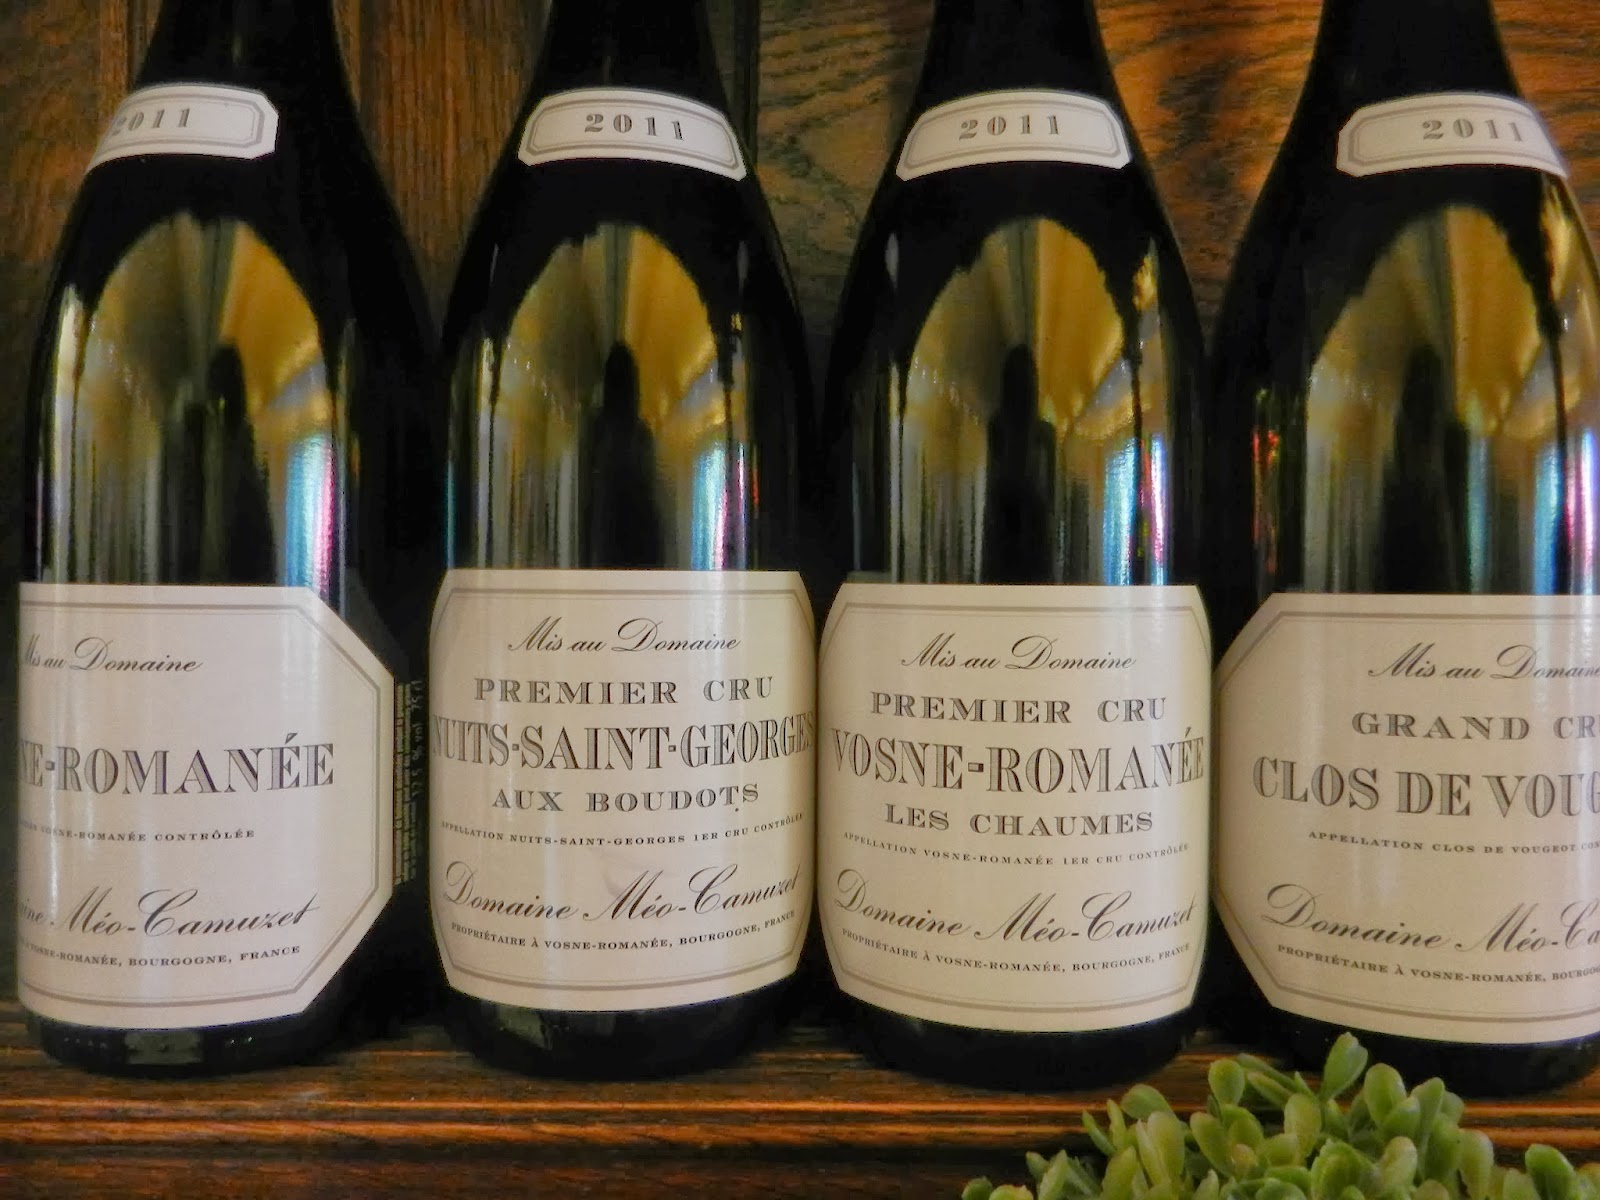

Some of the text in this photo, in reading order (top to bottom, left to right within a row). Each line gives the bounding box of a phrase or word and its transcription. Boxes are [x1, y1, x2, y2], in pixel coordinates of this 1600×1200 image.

[111, 106, 190, 136] 2011
[584, 113, 684, 141] 2011
[958, 114, 1059, 141] 2011
[1422, 118, 1524, 142] 2011
[507, 615, 742, 653] Mis au Domaine
[901, 632, 1138, 671] Mis au Domaine
[44, 656, 67, 669] au
[69, 636, 204, 672] Domaine
[1367, 642, 1437, 678] Mis
[1442, 665, 1486, 679] au
[474, 676, 774, 705] PREMIER CRU
[870, 691, 1167, 724] PREMIER CRU
[431, 710, 815, 771] NUITS-SAINT-GEORGES
[1351, 711, 1600, 741] GRAND CR
[830, 727, 1205, 794] VOSNE-ROMANÉE
[491, 783, 760, 813] AUX BOUDOTS
[1252, 756, 1380, 811] CLOS
[1395, 771, 1471, 817] DE
[154, 828, 255, 842] CONTRÔLÉE
[441, 812, 804, 846] APPELLATION NUITS-SAINT-GEORGES 1ER CRU CONTRÔLÉE
[885, 803, 1154, 837] LES CHAUMES
[843, 831, 1189, 866] APPELLATION VOSNE-ROMANÉE 1ER CRU CONTRÔLÉE
[1308, 831, 1424, 851] APPELLATION
[1432, 843, 1476, 854] CLOS
[1484, 846, 1504, 854] DE
[1512, 843, 1576, 854] VOUGEOT
[442, 861, 802, 921] Domaine Méo-Camuzet
[833, 868, 1199, 942] Domaine Méo-Camuzet
[50, 886, 321, 938] Méo-Camuzet
[1260, 883, 1453, 949] Domaine
[451, 909, 796, 951] PROPRIÉTAIRE À VOSNE-ROMANÉE, BOURGOGNE, FRANCE
[128, 955, 233, 967] BOURGOGNE,
[239, 945, 301, 962] FRANCE
[841, 928, 1191, 973] PROPRIÉTAIRE À VOSNE-ROMANÉE, BOURGOGNE, FRANCE
[1277, 944, 1389, 974] PROPRIÉTAIRE
[1394, 964, 1404, 976] À
[1410, 968, 1547, 983] VOSNE-ROMANÉE,
